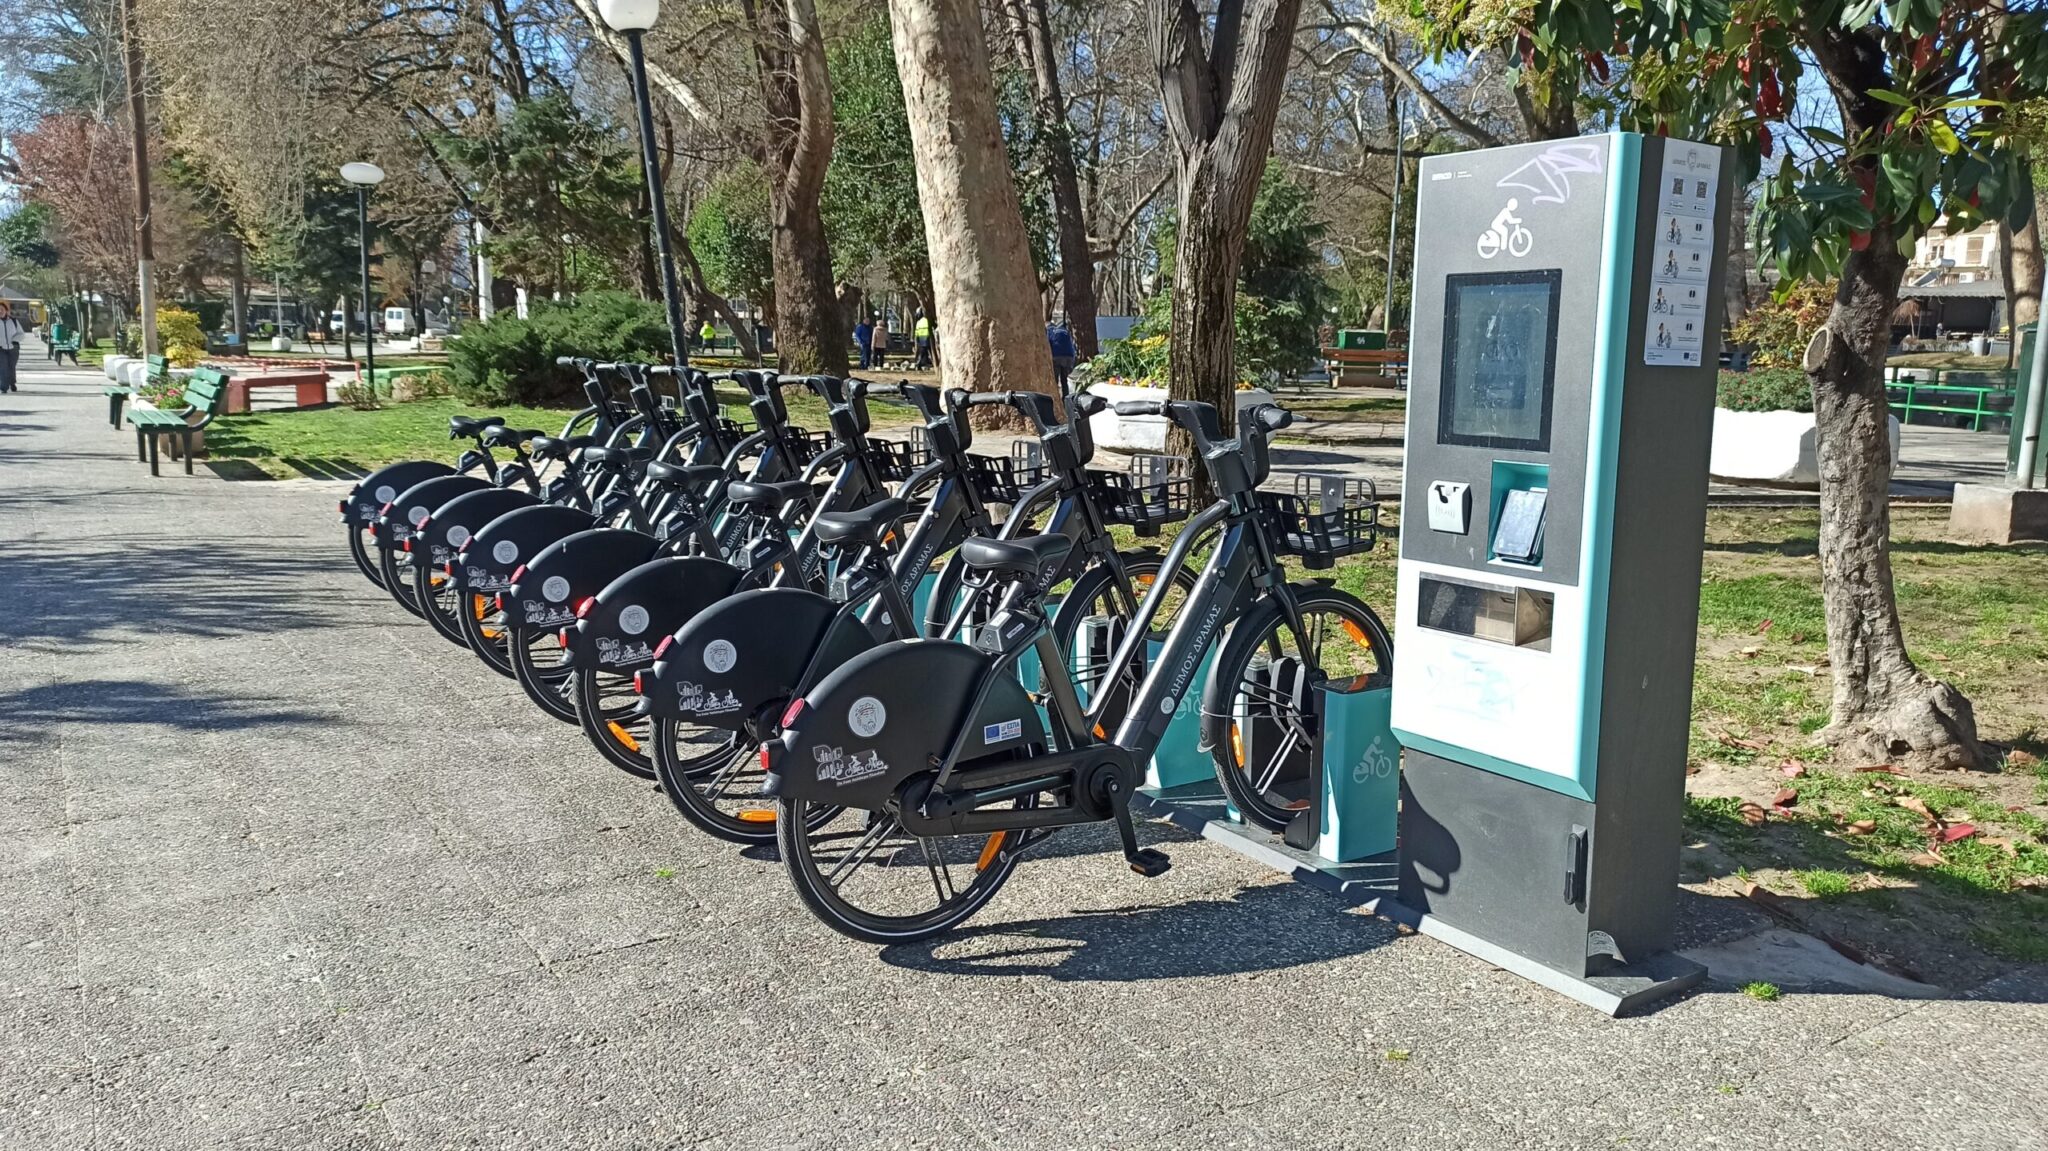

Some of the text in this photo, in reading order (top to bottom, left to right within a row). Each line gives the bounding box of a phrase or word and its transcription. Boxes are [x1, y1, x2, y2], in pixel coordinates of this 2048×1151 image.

[726, 520, 745, 548] ΔΗΜΟΣ
[801, 543, 819, 572] ΔΗΜΟ
[909, 543, 934, 580] ΔΡΑΜΑΣ
[1170, 604, 1222, 697] ΔΗΜΟΣ ΔΡΑΜΑΣ
